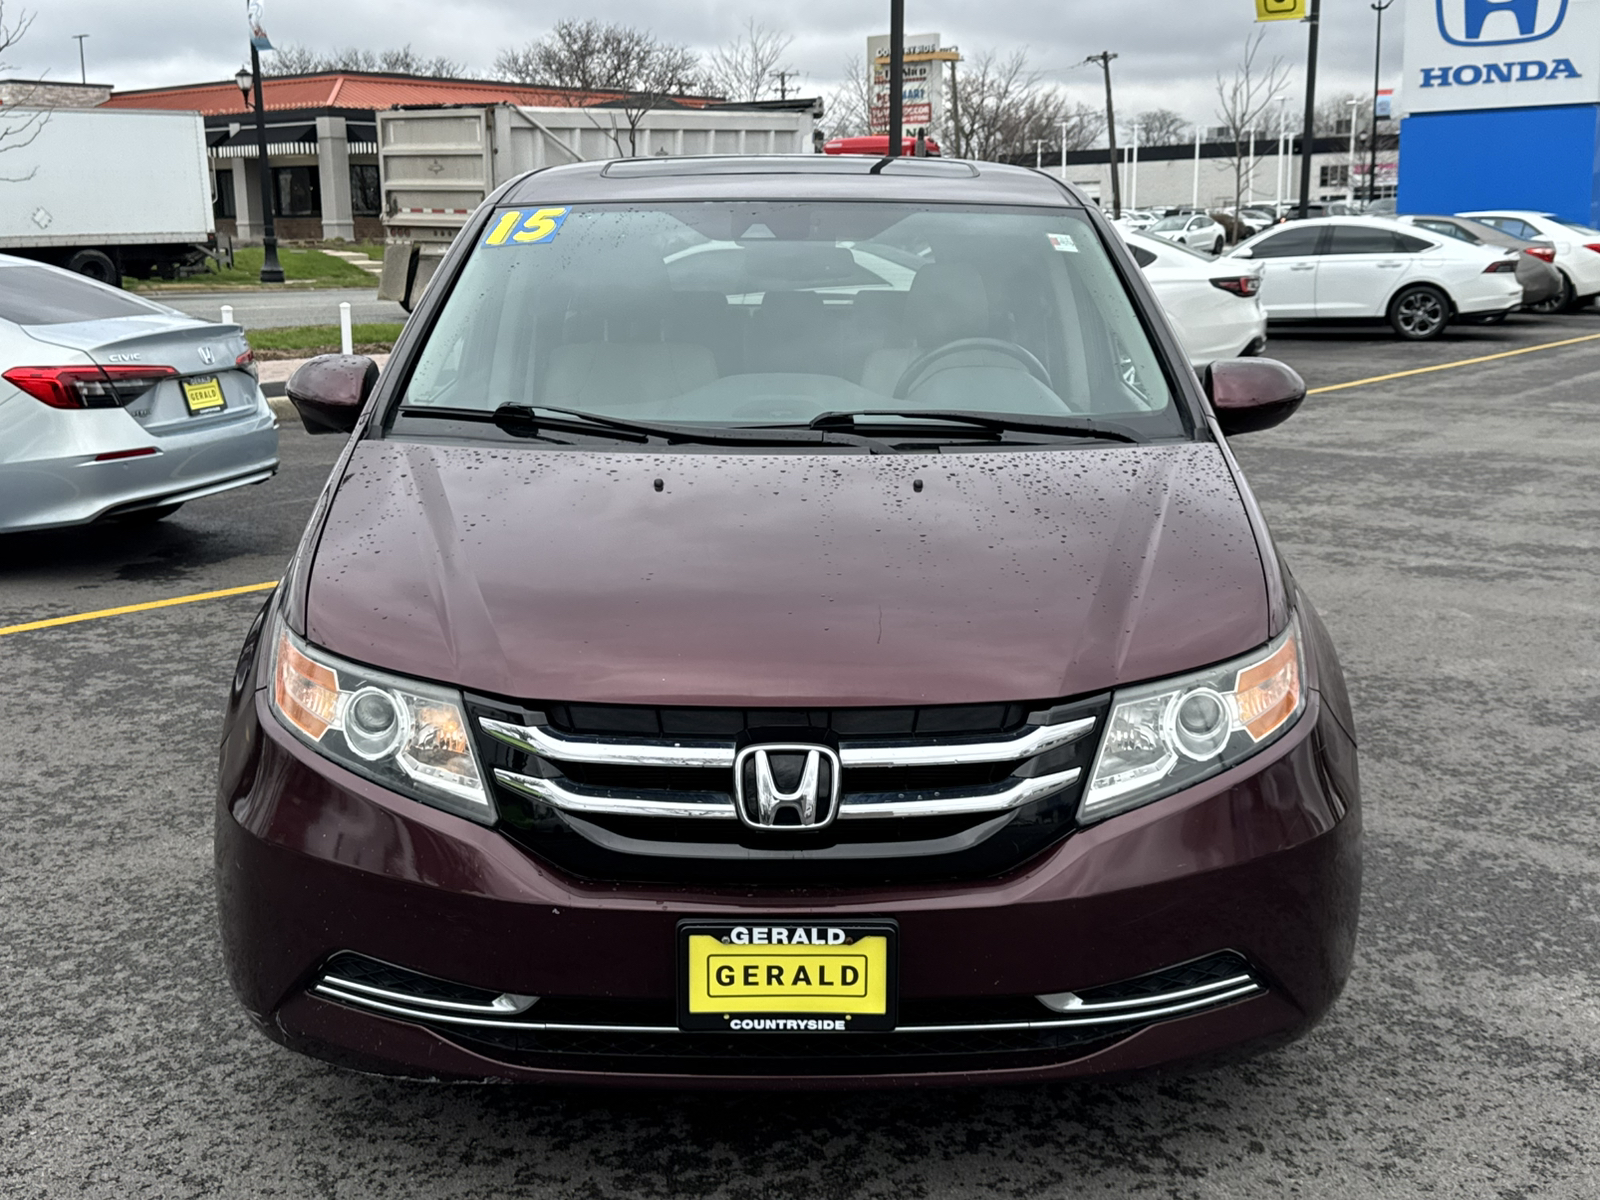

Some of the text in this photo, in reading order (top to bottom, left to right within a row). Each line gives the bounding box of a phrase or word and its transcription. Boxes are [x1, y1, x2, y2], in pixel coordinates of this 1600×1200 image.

[1419, 58, 1582, 88] HONDA
[485, 207, 567, 245] 15
[109, 353, 141, 362] CIVIC
[190, 389, 217, 401] GERALD
[730, 926, 846, 945] GERALD
[715, 965, 859, 987] GERALD
[730, 1019, 846, 1031] COUNTRYSIDE
